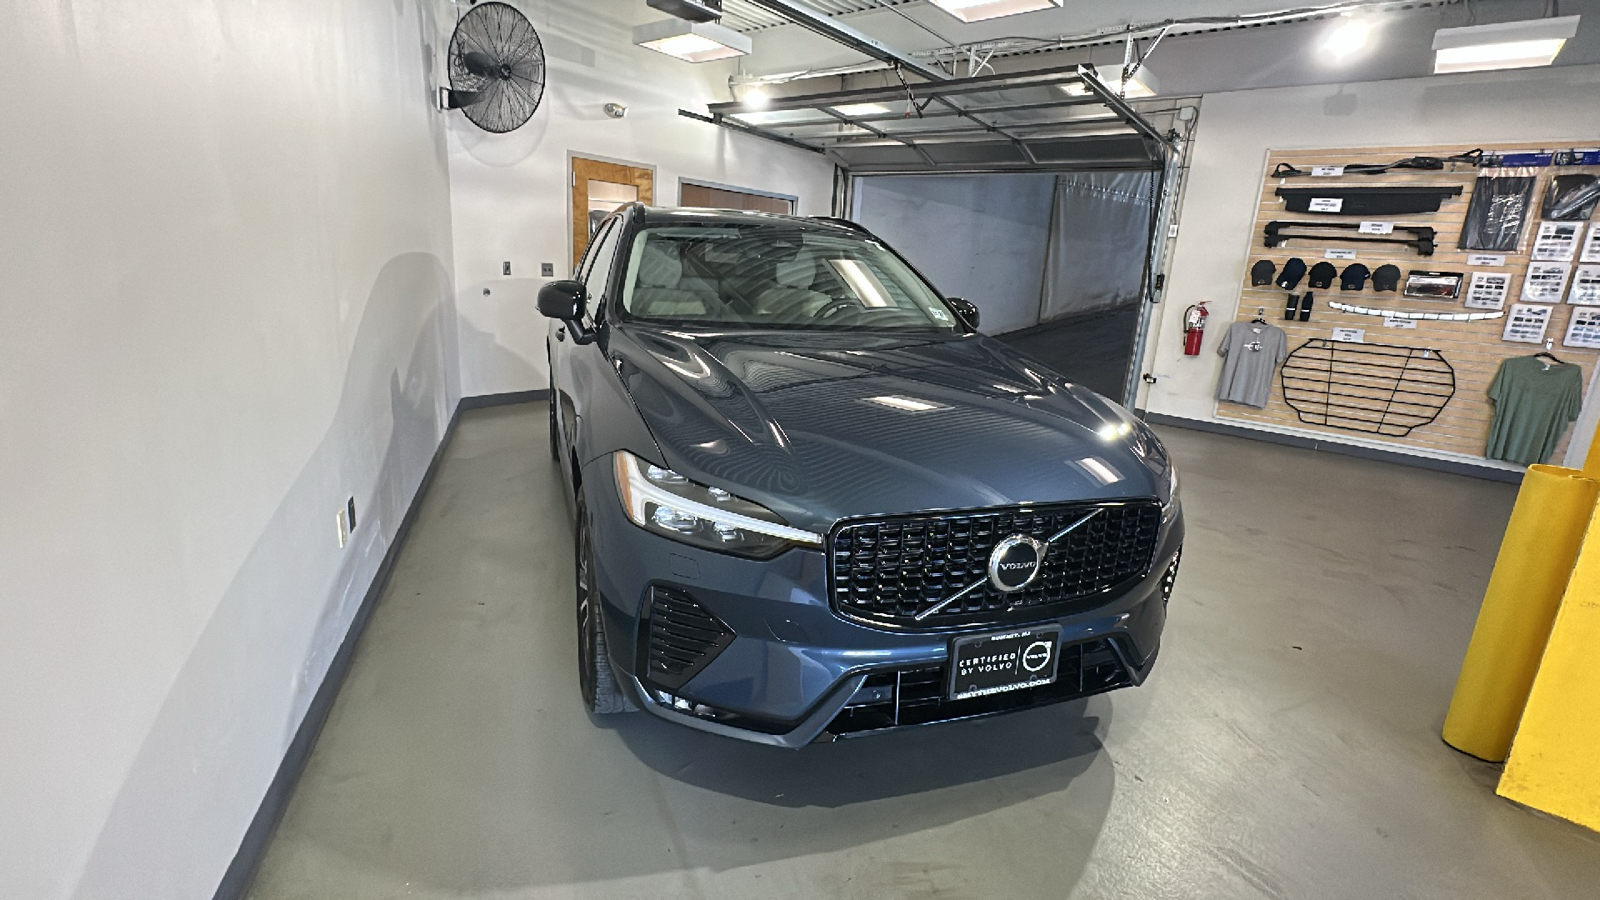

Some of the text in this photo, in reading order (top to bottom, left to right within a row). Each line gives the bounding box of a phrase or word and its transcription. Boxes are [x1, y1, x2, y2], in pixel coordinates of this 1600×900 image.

[999, 561, 1036, 571] VOLVO
[959, 652, 1016, 668] CERTIFIED
[961, 661, 1013, 676] BY VOLVO
